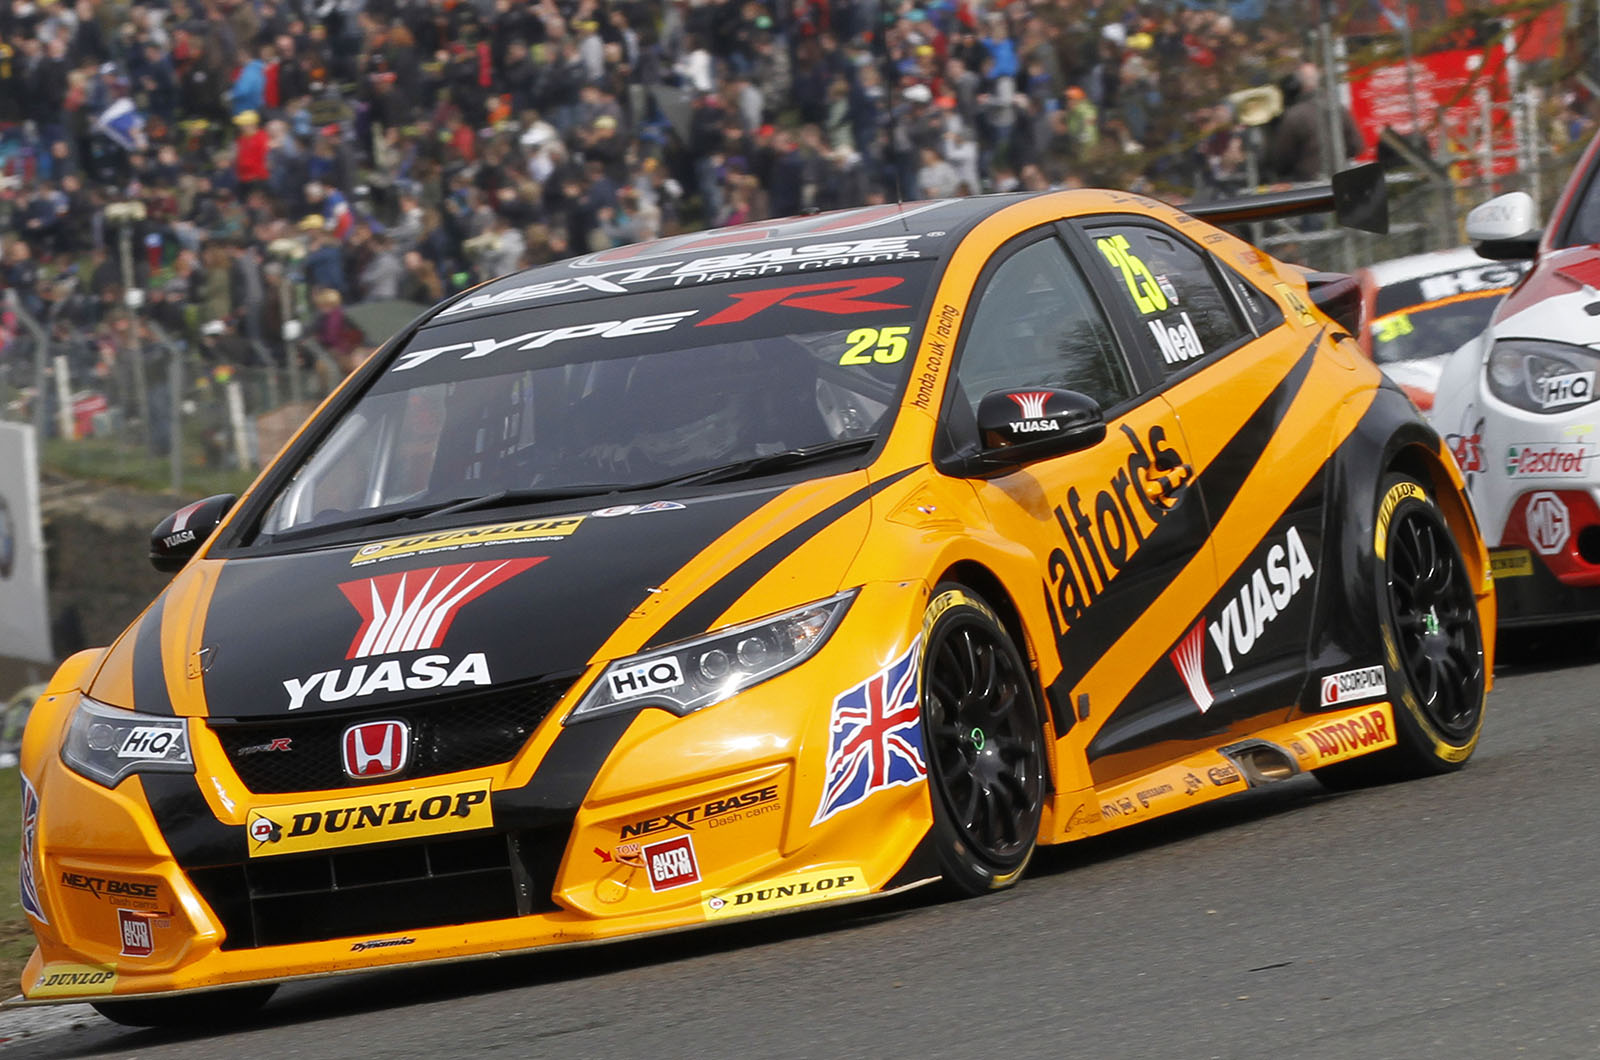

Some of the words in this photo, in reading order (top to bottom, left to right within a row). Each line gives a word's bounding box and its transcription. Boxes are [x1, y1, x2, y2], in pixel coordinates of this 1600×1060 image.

[1097, 234, 1168, 315] 25
[392, 310, 700, 373] TYPE
[694, 276, 912, 328] R
[1147, 311, 1205, 364] Neal
[839, 326, 911, 366] 25
[1546, 377, 1588, 402] HiQ
[1009, 420, 1060, 433] YUASA
[1519, 448, 1587, 474] Castrol
[163, 529, 196, 548] YUASA
[391, 519, 582, 549] DUNLOP
[379, 551, 415, 562] British
[419, 545, 459, 555] Touring
[484, 535, 564, 546] Championship
[1208, 526, 1314, 674] YUASA
[282, 653, 493, 711] YUASA
[612, 663, 679, 695] HiQ
[1340, 669, 1386, 693] SCORPION
[123, 731, 173, 753] HiQ
[1307, 710, 1390, 758] AUTOCAR
[287, 790, 487, 838] DUNLOP
[708, 813, 743, 829] Dash
[746, 803, 782, 819] cams
[616, 843, 640, 855] TOW
[652, 847, 689, 868] AUTO
[654, 863, 693, 882] GLYM
[110, 895, 132, 906] Dash
[133, 901, 159, 909] cams
[734, 876, 855, 906] DUNLOP
[124, 920, 148, 937] AUTO
[125, 933, 151, 949] GLYM
[350, 936, 417, 952] Dynamics
[45, 971, 115, 986] DUNLOP
